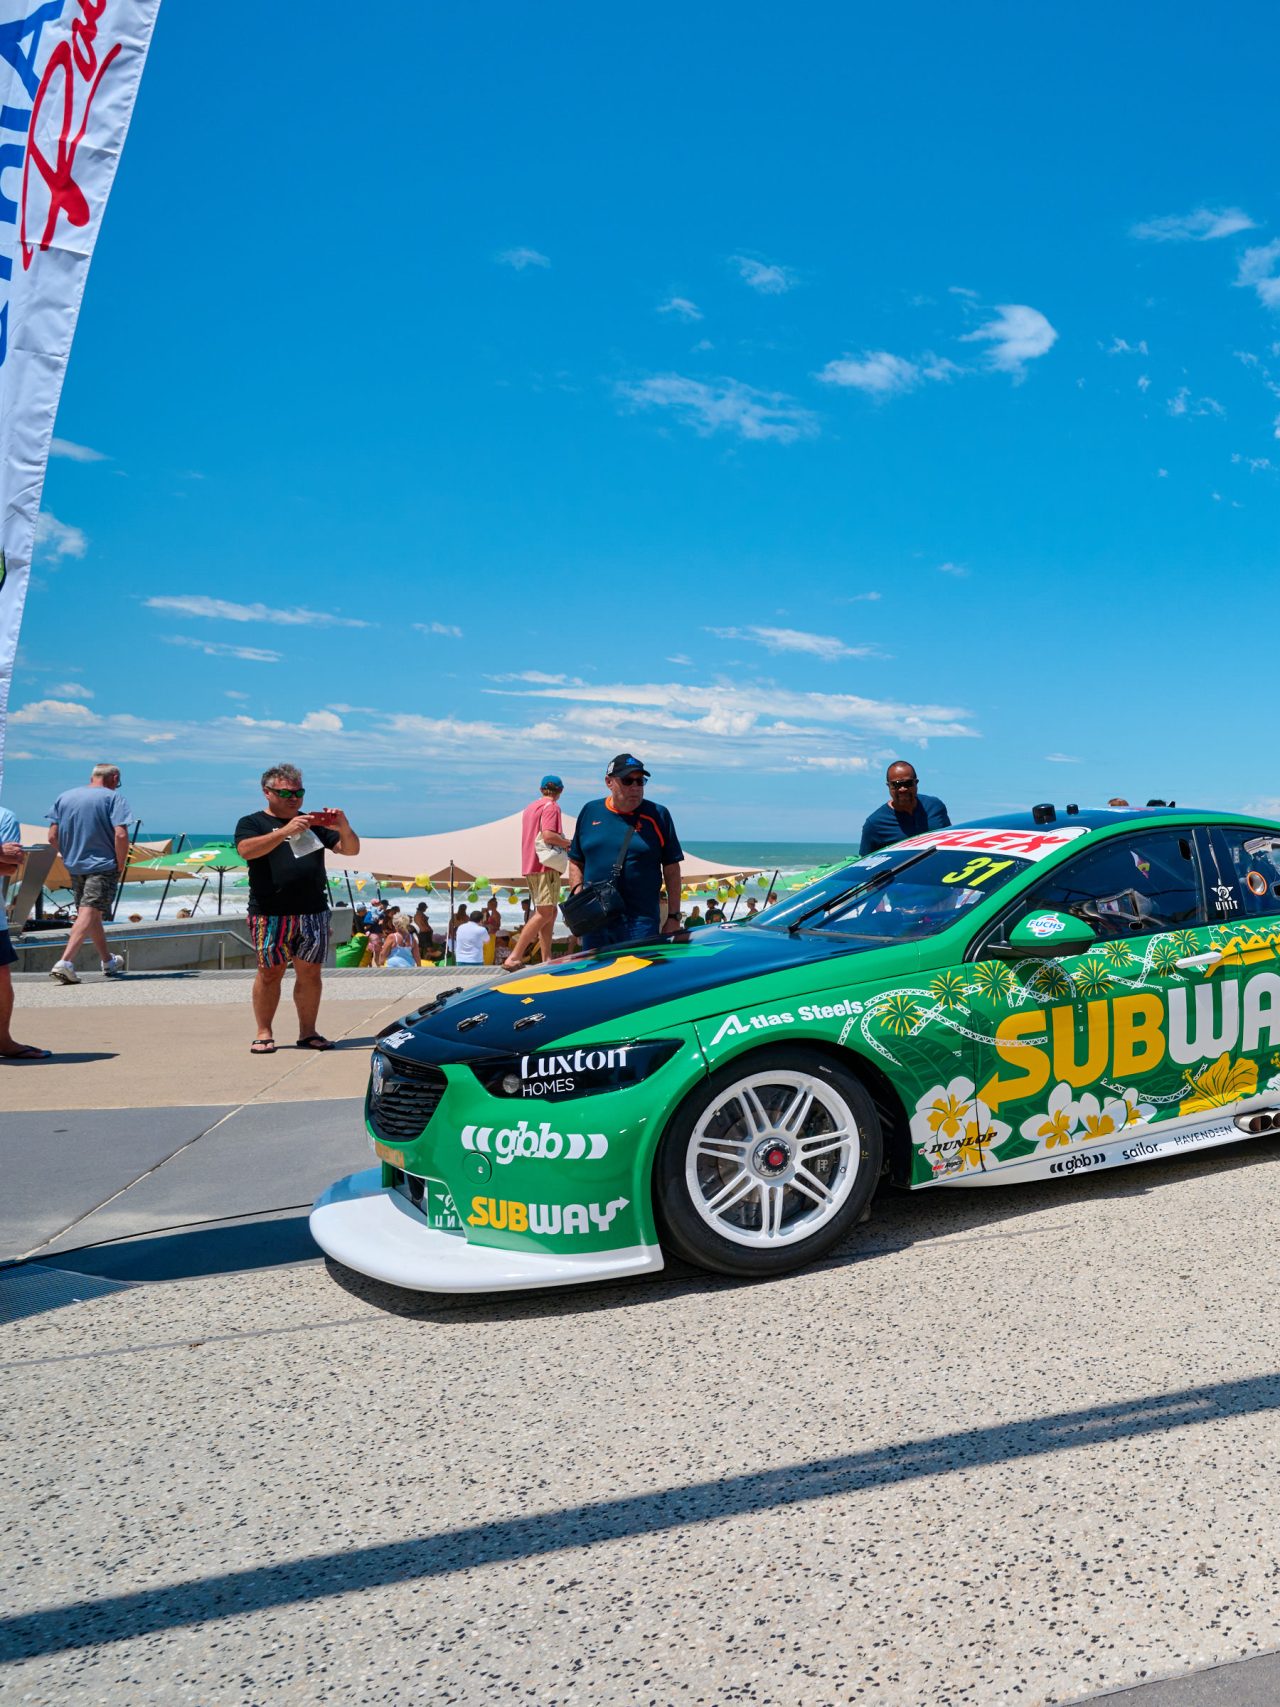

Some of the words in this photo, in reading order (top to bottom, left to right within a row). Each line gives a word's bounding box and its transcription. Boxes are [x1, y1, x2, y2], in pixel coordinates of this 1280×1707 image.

[941, 857, 1015, 887] 31
[1029, 920, 1063, 931] FUCHS
[709, 1014, 795, 1047] Atlas
[797, 999, 864, 1022] Steels
[521, 1048, 627, 1080] Luxton
[522, 1077, 575, 1098] HOMES
[929, 1131, 998, 1155] DUNLOP
[466, 1195, 631, 1235] SUBWAY
